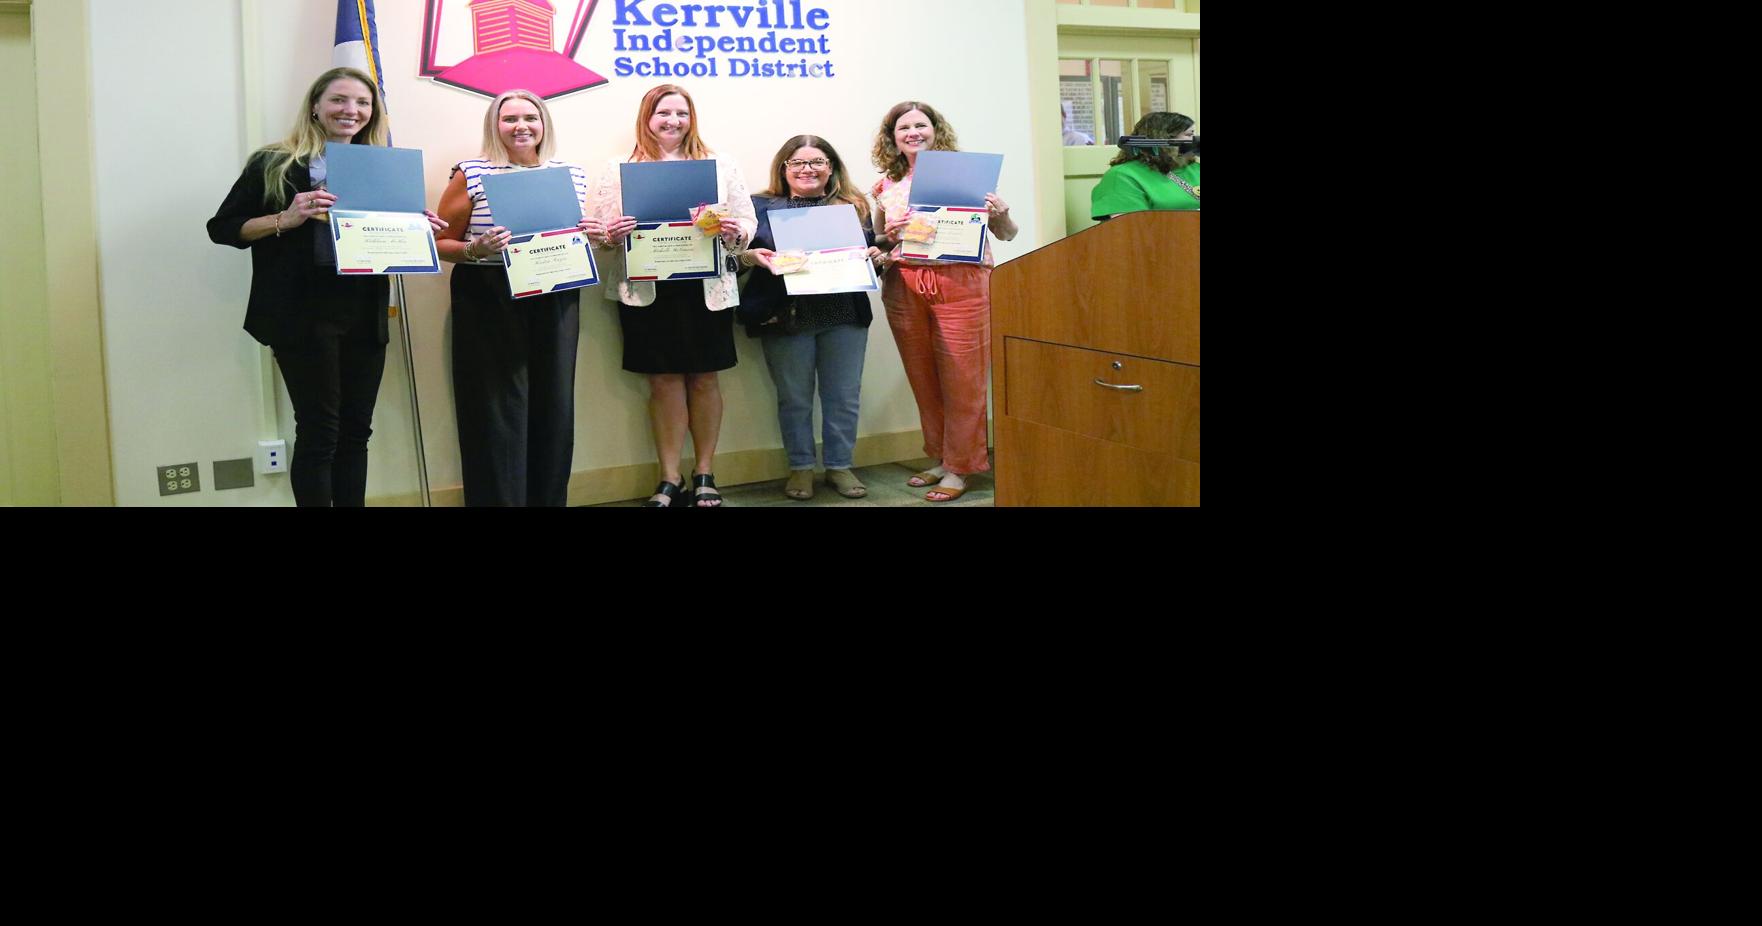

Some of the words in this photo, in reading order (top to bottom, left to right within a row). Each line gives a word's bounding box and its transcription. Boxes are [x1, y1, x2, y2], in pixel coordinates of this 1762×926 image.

[612, 0, 830, 31] Kerrville
[612, 28, 831, 59] Independent
[614, 56, 719, 78] School
[728, 58, 835, 78] District
[529, 244, 566, 255] CERTIFICATE
